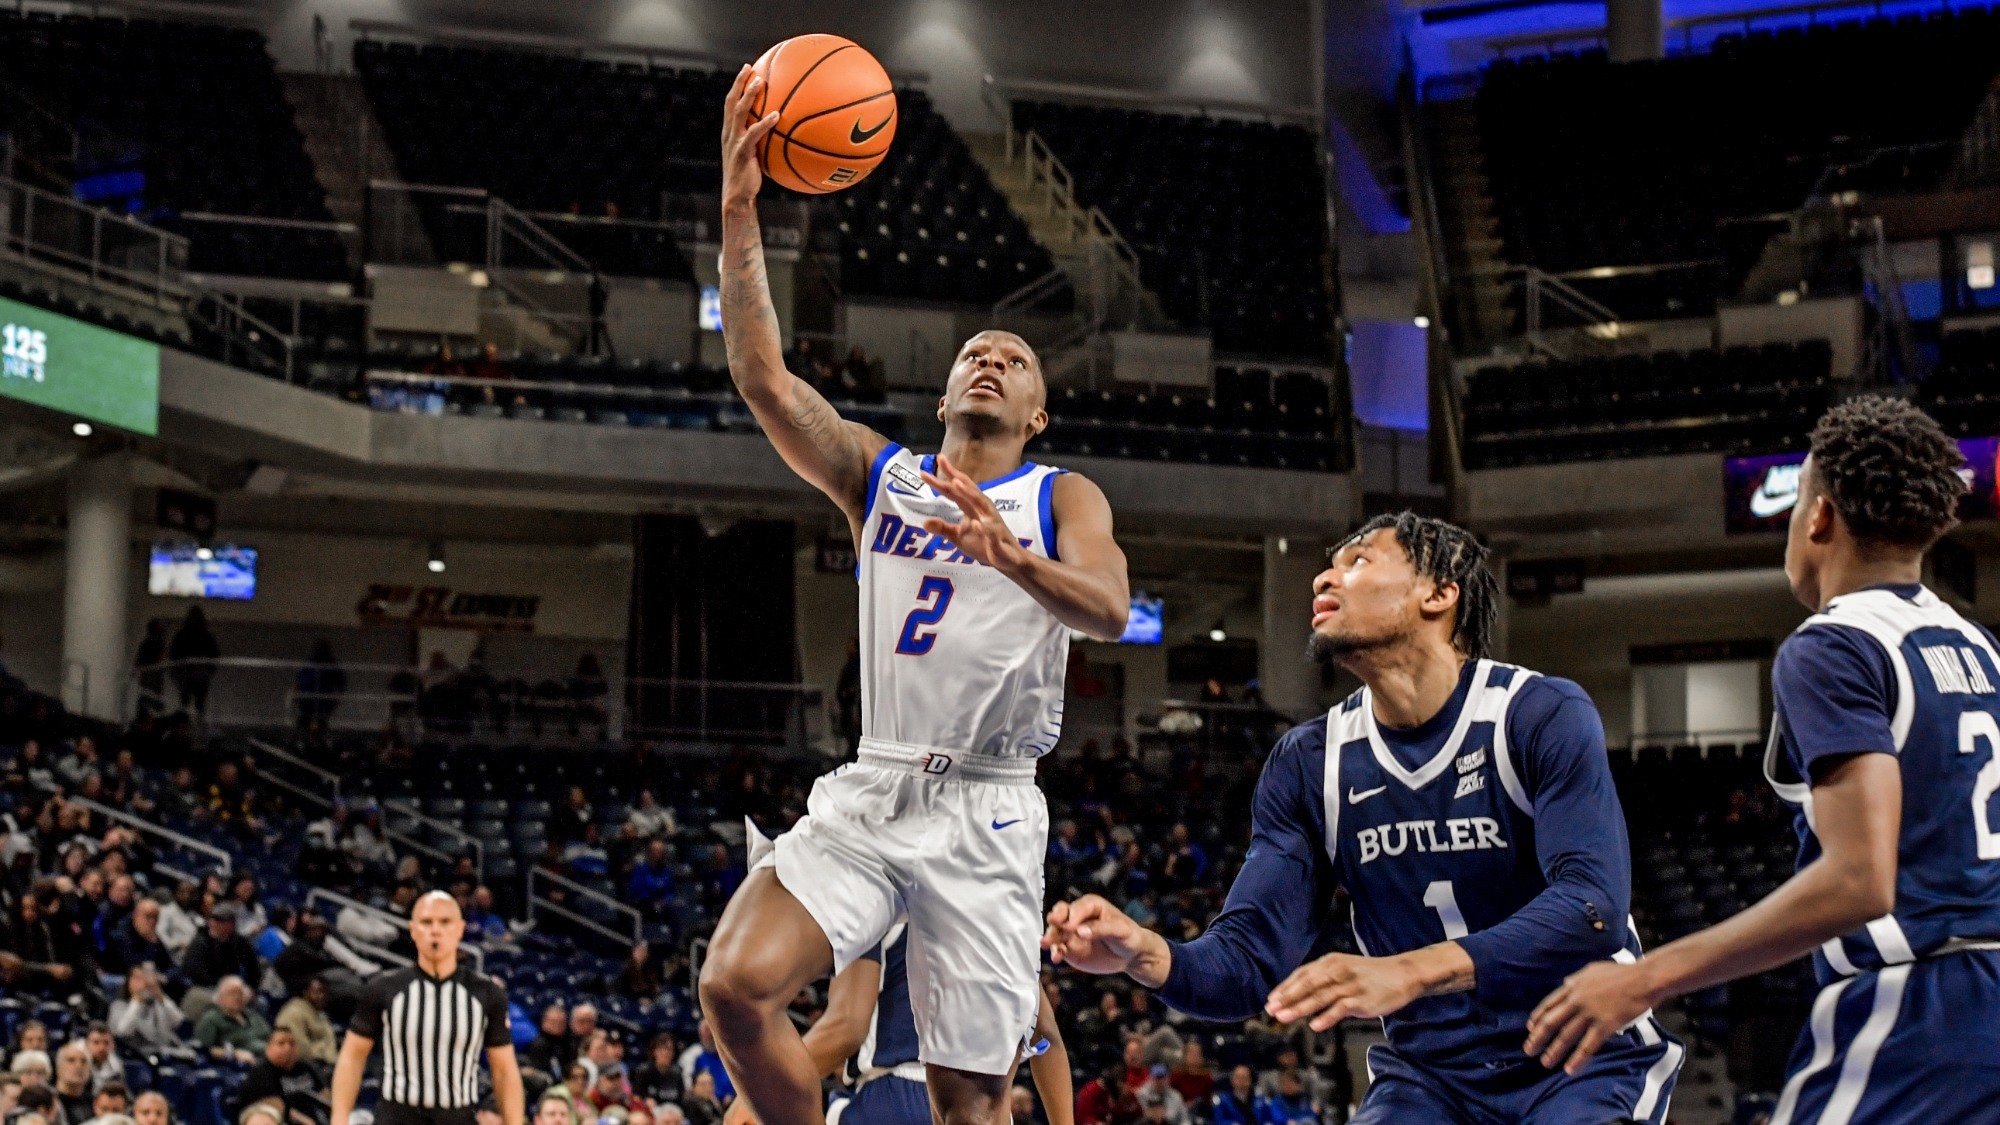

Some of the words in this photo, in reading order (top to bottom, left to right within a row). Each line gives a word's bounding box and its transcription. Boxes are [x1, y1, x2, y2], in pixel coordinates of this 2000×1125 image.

[2, 323, 47, 364] 125
[895, 575, 954, 656] 2
[1958, 711, 2000, 860] 2
[1357, 817, 1508, 864] BUTLER
[1422, 880, 1469, 941] 1
